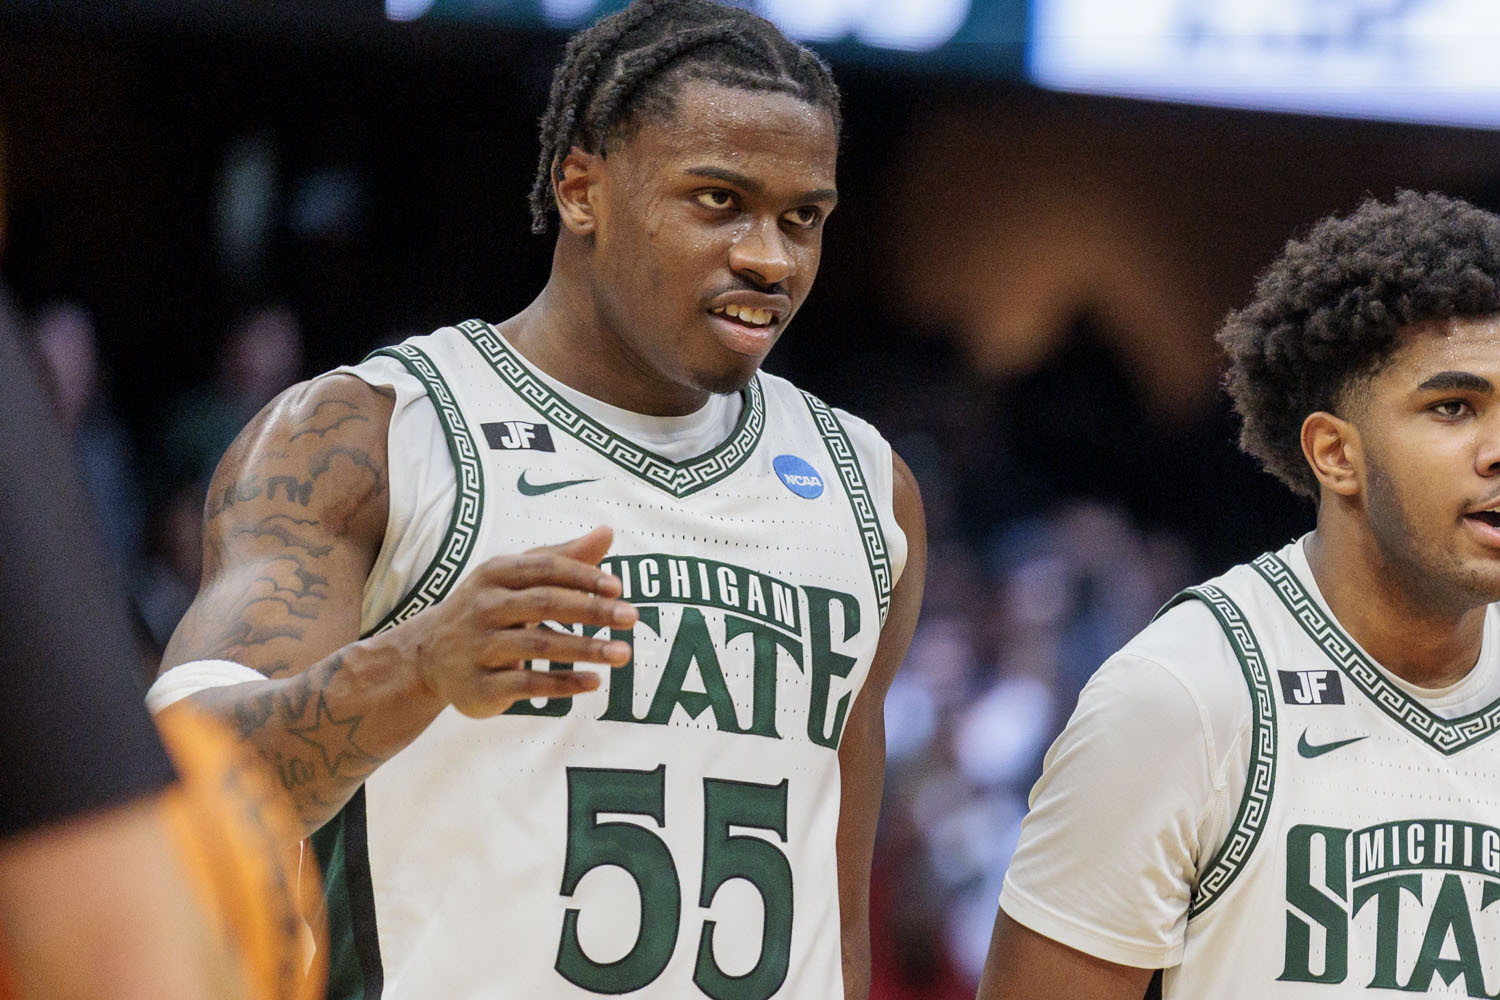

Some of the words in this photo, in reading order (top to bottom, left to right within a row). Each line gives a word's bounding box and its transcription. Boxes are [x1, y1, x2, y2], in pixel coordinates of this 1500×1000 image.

[500, 421, 536, 449] JF
[783, 473, 822, 487] NCAA
[1293, 671, 1328, 704] JF
